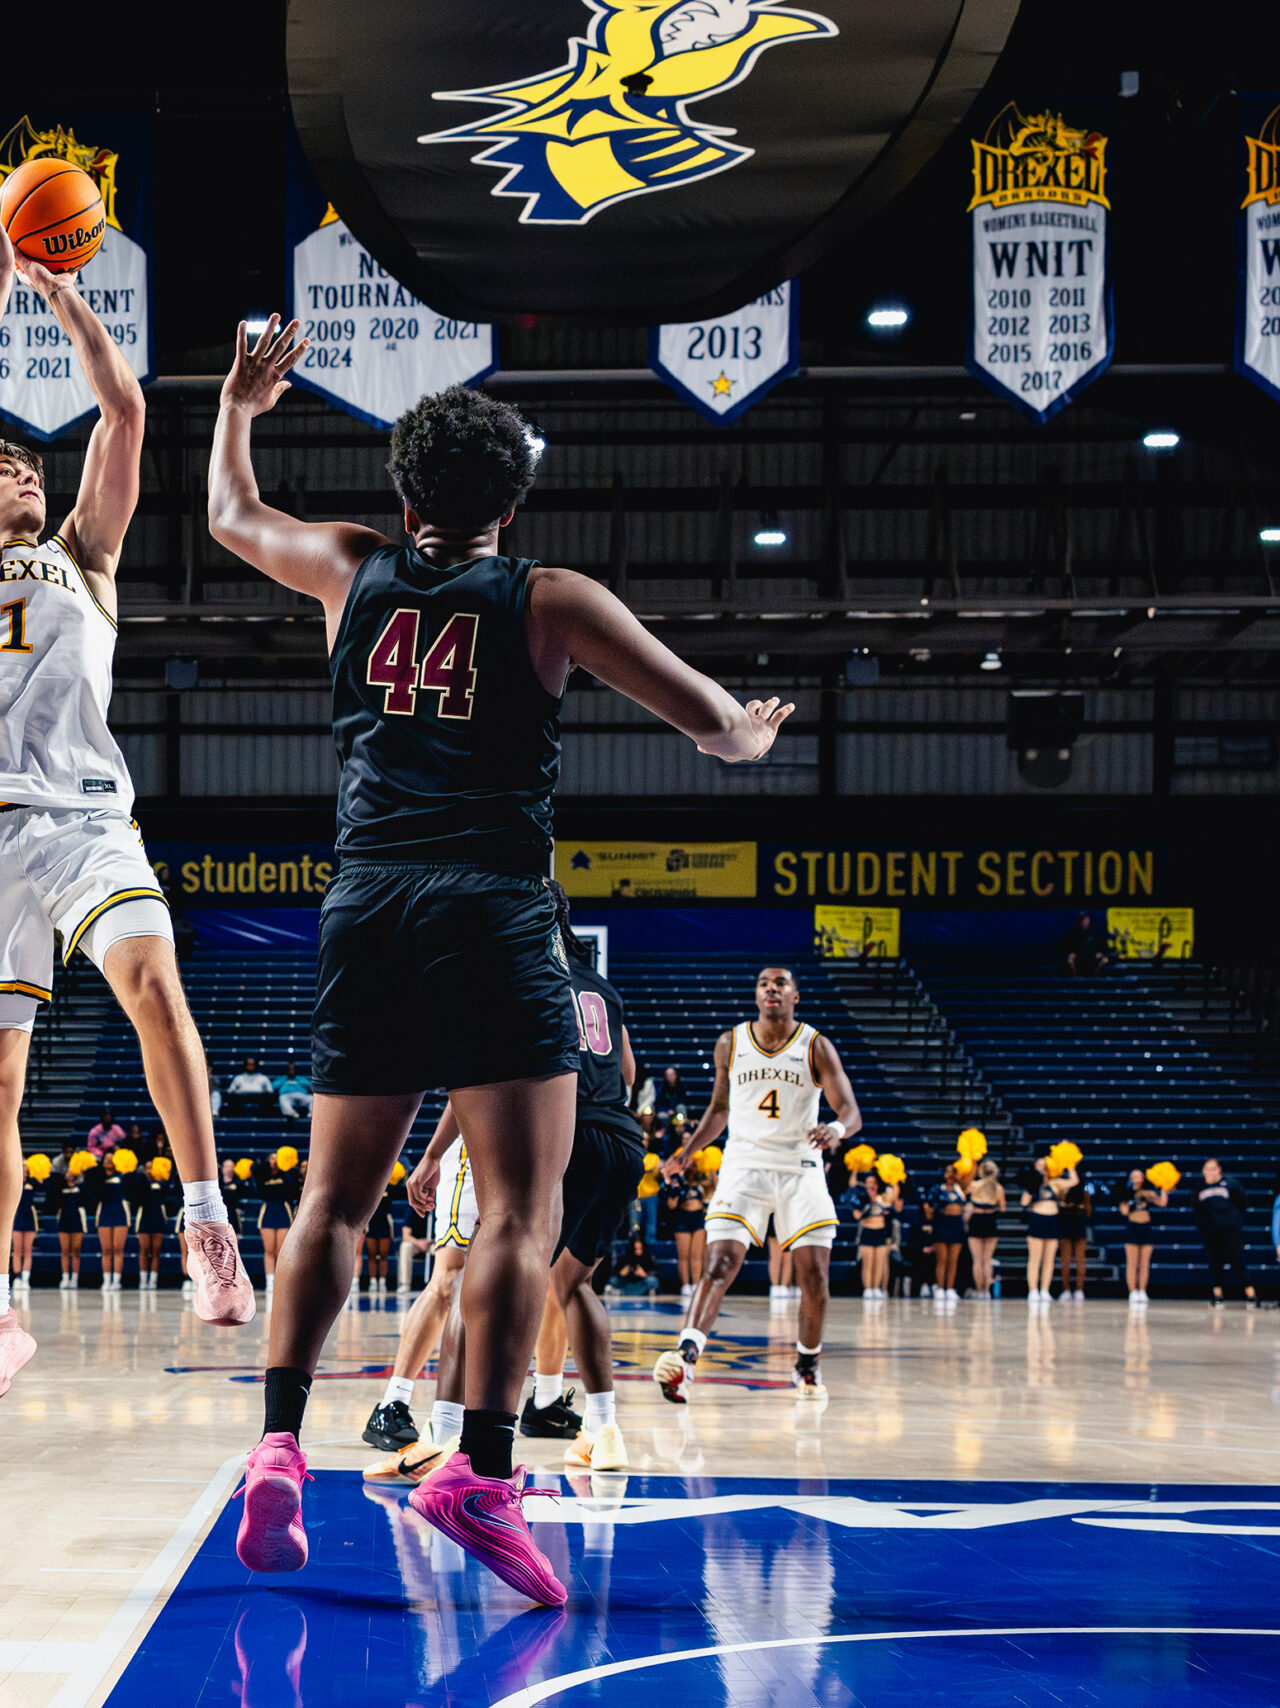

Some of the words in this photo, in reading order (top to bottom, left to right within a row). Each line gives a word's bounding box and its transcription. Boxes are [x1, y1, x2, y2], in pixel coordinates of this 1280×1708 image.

[980, 149, 1100, 197] DREXEL
[983, 213, 1027, 232] WOMENS
[1030, 211, 1098, 233] BASKETBALL
[41, 217, 105, 256] Wilson
[989, 239, 1093, 279] WNIT
[308, 282, 422, 310] TOURNA
[988, 289, 1031, 309] 2010
[1048, 287, 1085, 307] 2011
[304, 319, 356, 342] 2009
[370, 317, 419, 340] 2020
[434, 318, 480, 340] 2021
[988, 316, 1030, 336] 2012
[1049, 313, 1091, 334] 2013
[687, 325, 763, 361] 2013
[987, 343, 1032, 364] 2015
[1049, 341, 1092, 362] 2016
[26, 357, 70, 379] 2021
[304, 347, 353, 369] 2024
[1021, 371, 1062, 392] 2017
[0, 597, 34, 654] 1
[366, 608, 480, 721] 44
[181, 852, 333, 893] students
[773, 851, 964, 897] STUDENT
[976, 850, 1154, 897] SECTION
[737, 1067, 804, 1088] DREXEL
[757, 1088, 781, 1120] 4
